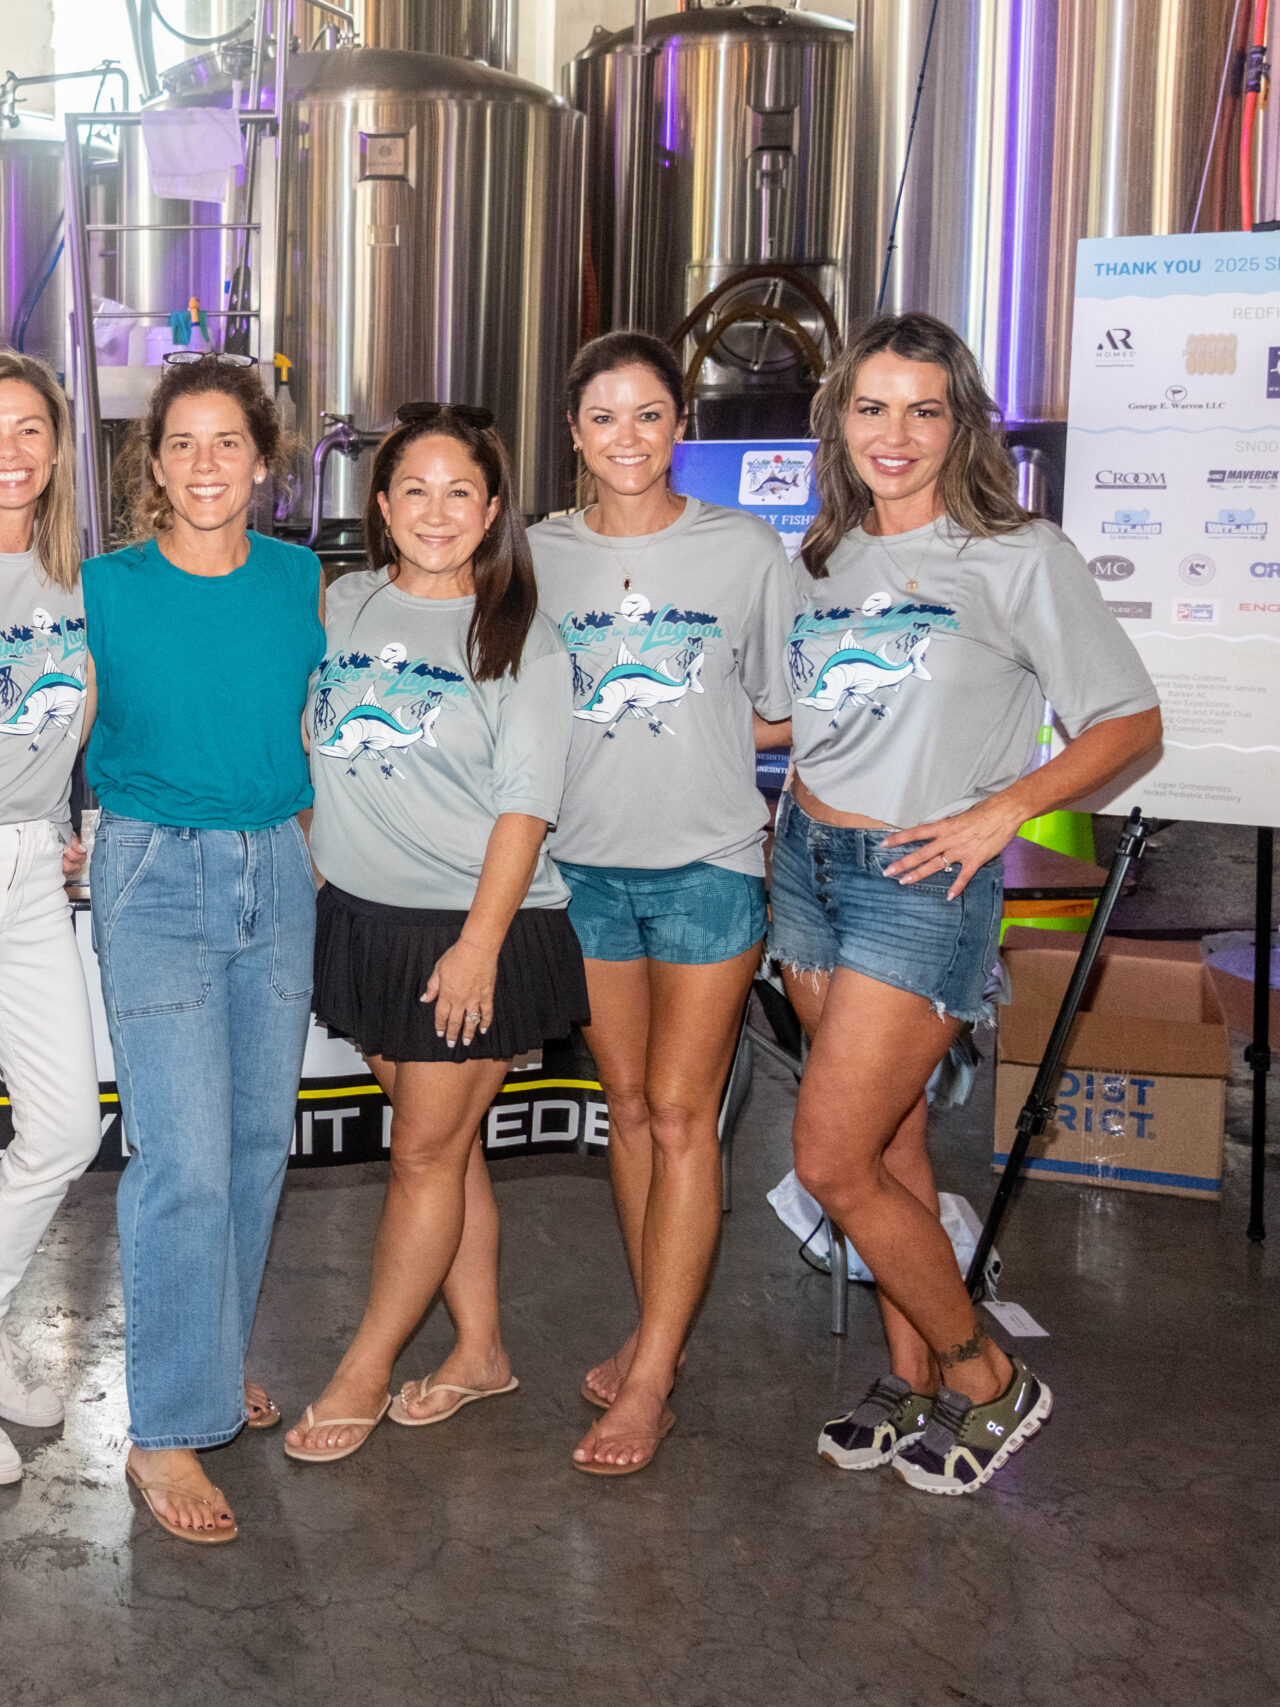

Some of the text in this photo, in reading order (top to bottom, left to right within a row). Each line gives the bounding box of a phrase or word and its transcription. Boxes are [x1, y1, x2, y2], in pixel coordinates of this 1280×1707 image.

[1094, 261, 1157, 277] THANK
[1163, 259, 1201, 274] YOU
[1214, 257, 1260, 273] 2025
[1128, 401, 1226, 411] George E. Warren LLC
[1095, 470, 1166, 484] CROOM
[1227, 470, 1279, 480] MAVERICK
[1094, 562, 1128, 576] MC
[612, 627, 625, 637] in
[627, 624, 649, 637] the
[640, 603, 723, 654] Lagoon
[312, 650, 365, 695] Lines
[383, 657, 470, 698] Lagoon
[1198, 682, 1232, 692] Medicine
[1234, 684, 1267, 693] Services
[1192, 709, 1207, 717] and
[1233, 711, 1252, 719] Club
[1176, 716, 1228, 726] Construction
[1172, 725, 1224, 734] Construction
[1179, 782, 1232, 793] Orthodontics
[1168, 790, 1203, 799] Pediatric
[1204, 792, 1242, 803] Dentistry
[1058, 1071, 1156, 1105] DIST
